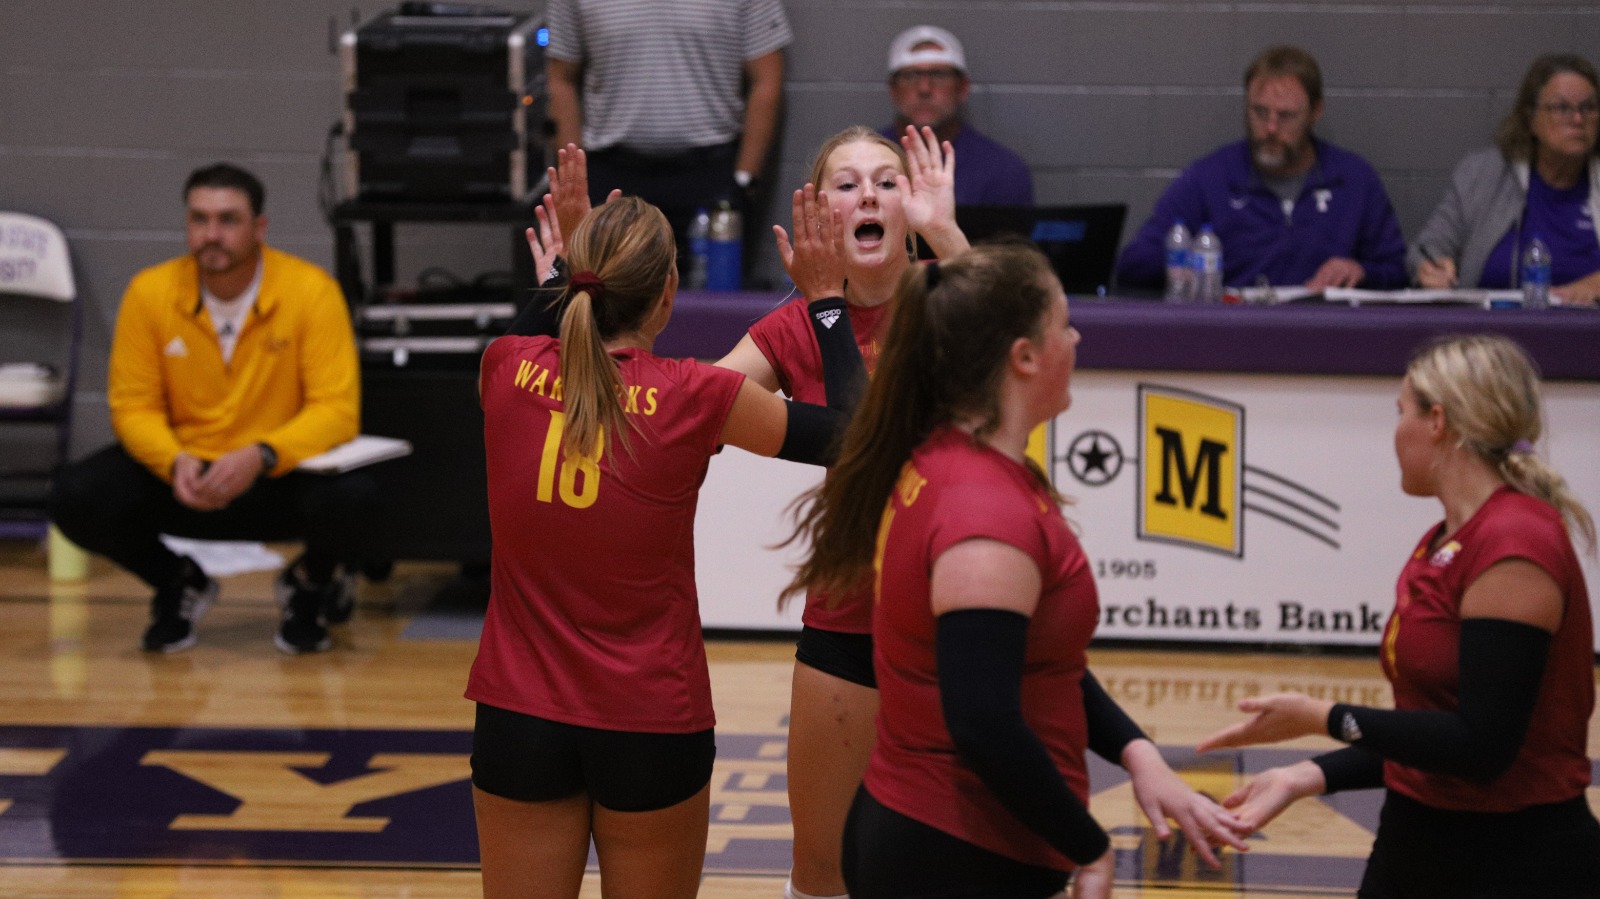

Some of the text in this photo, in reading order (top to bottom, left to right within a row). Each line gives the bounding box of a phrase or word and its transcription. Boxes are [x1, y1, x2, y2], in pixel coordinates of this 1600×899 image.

[816, 308, 842, 320] adidas
[514, 359, 658, 416] WARKS
[536, 409, 605, 509] 18
[1154, 427, 1228, 521] M
[1098, 559, 1157, 579] 1905
[1104, 598, 1384, 634] rchants Bank
[0, 748, 472, 833] Y
